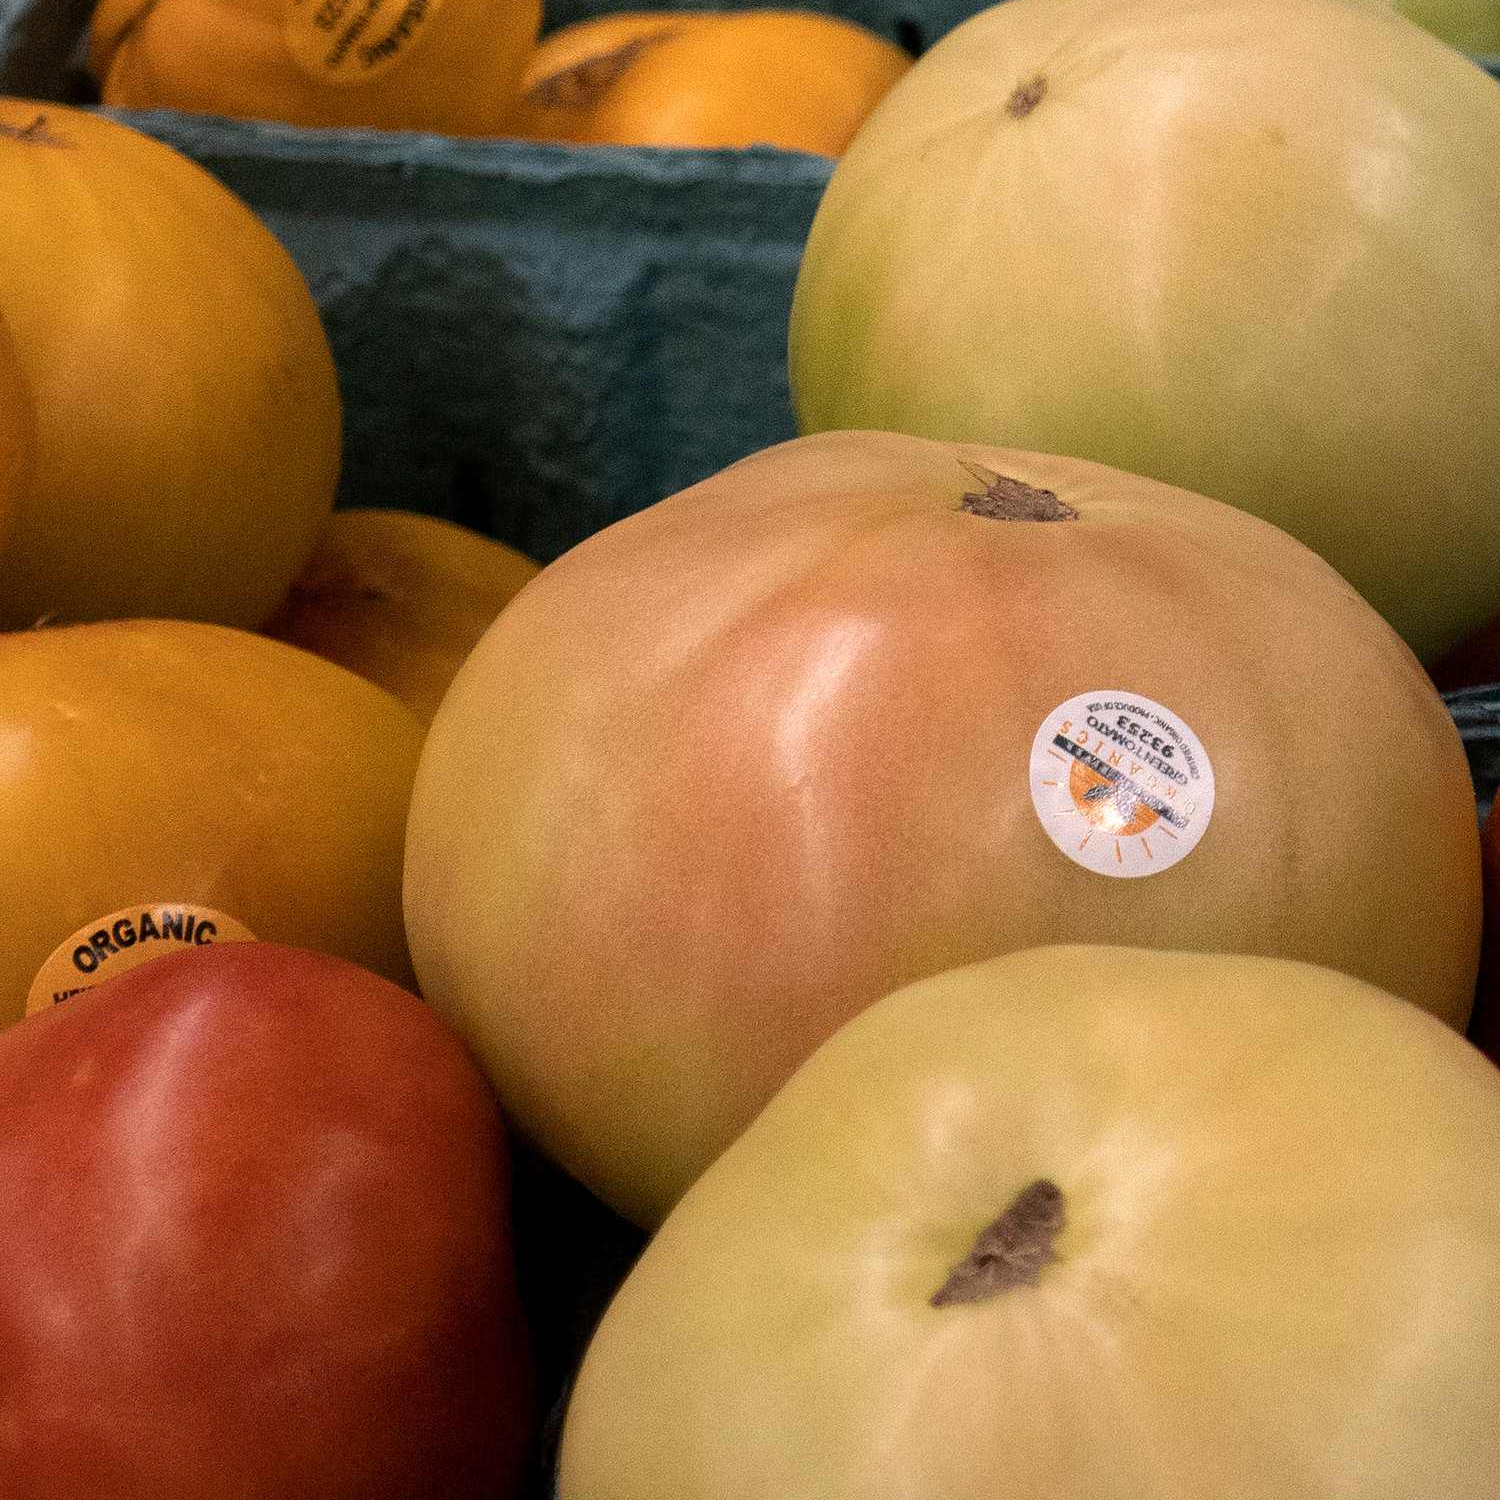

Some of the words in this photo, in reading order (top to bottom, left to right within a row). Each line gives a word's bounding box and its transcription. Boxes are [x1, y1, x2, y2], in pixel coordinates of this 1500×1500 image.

[1087, 715, 1142, 758] TOMATO
[1116, 715, 1175, 758] 93253
[1144, 751, 1188, 786] GREEN
[72, 911, 217, 974] ORGANIC
